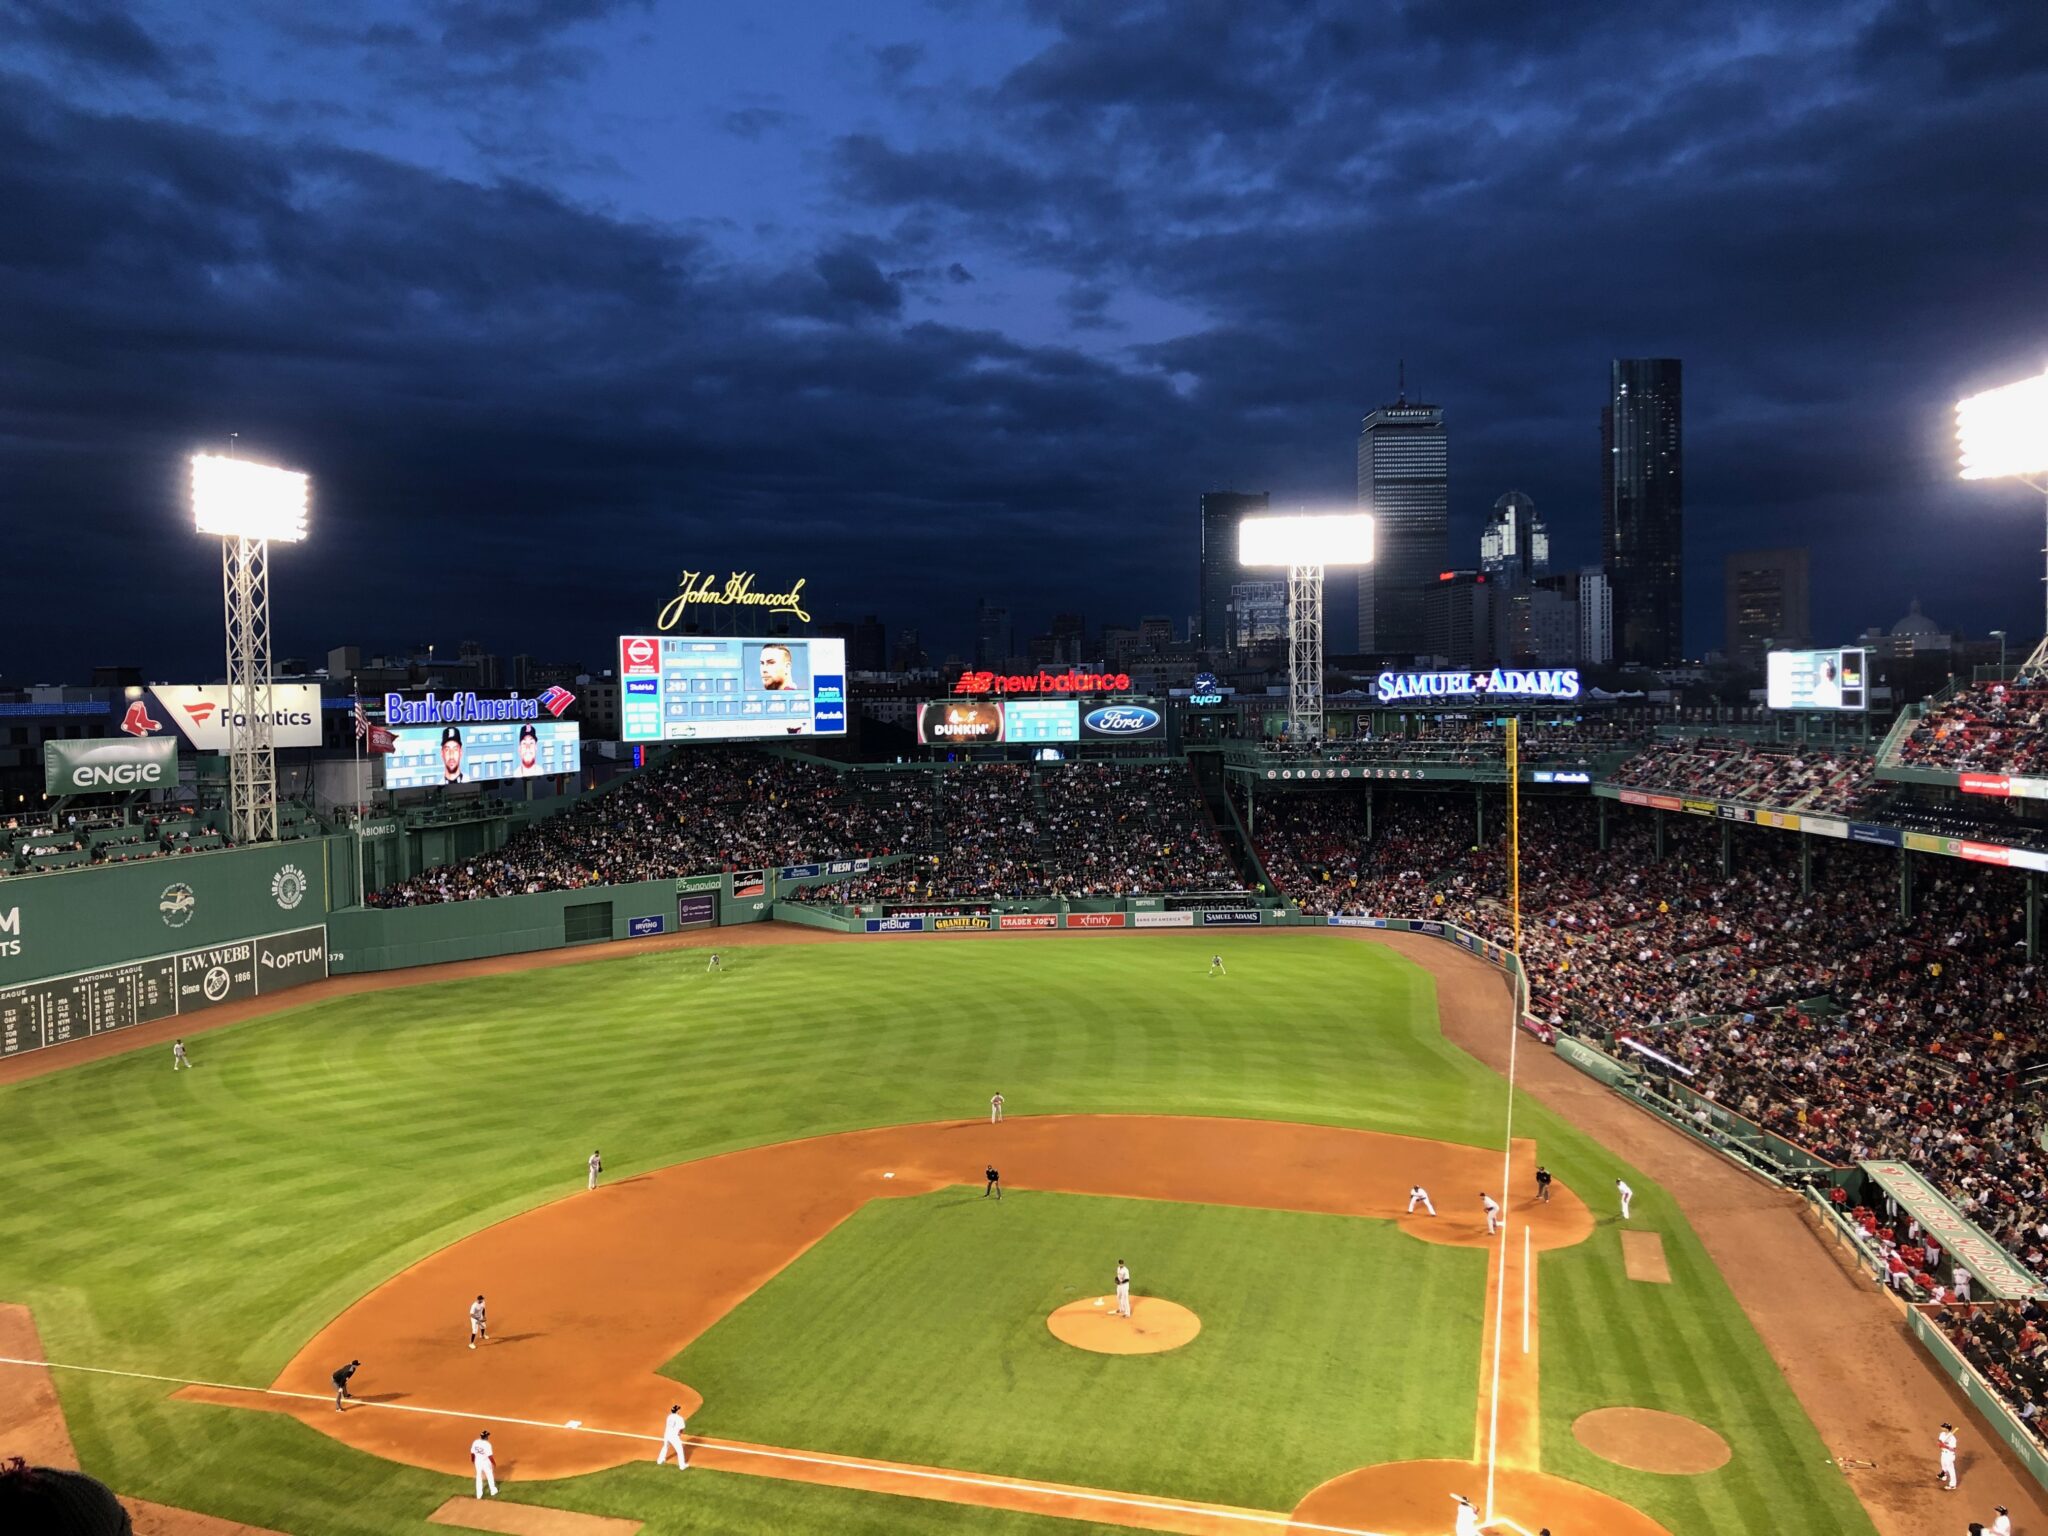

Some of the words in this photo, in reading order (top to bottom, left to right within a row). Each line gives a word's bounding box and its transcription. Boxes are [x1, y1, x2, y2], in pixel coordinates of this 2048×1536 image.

[657, 570, 720, 631] John
[719, 571, 811, 622] Hancock
[995, 674, 1038, 692] new
[1039, 670, 1130, 692] balance
[1378, 672, 1476, 700] SAMUEL
[1486, 668, 1579, 698] ADAMS
[1189, 694, 1222, 706] tyco
[385, 692, 441, 724] Bank
[441, 692, 464, 722] of
[464, 691, 538, 721] America
[1100, 710, 1145, 729] Ford
[934, 724, 989, 736] DUNKIN'
[362, 824, 396, 837] ABIOMED
[281, 864, 294, 875] 103
[832, 862, 852, 873] NESN
[734, 879, 763, 888] Safelite
[635, 921, 658, 930] IRVING
[879, 920, 910, 931] jetBlue
[936, 918, 970, 928] GRANITE
[972, 917, 989, 928] CITY
[1002, 918, 1032, 926] TRADER
[1034, 917, 1056, 926] JOE'S
[1080, 915, 1112, 926] xfinity
[182, 950, 208, 973] F.W.
[209, 944, 250, 966] WEBB
[276, 946, 322, 969] OPTUM
[328, 953, 344, 962] 379
[79, 972, 113, 984] NATIONAL
[116, 966, 142, 976] LEAGUE
[234, 971, 251, 983] 1866
[0, 989, 26, 1000] EAGUE
[181, 984, 200, 996] Since
[1913, 1205, 1968, 1233] RED
[1947, 1234, 2038, 1296] BOSTON
